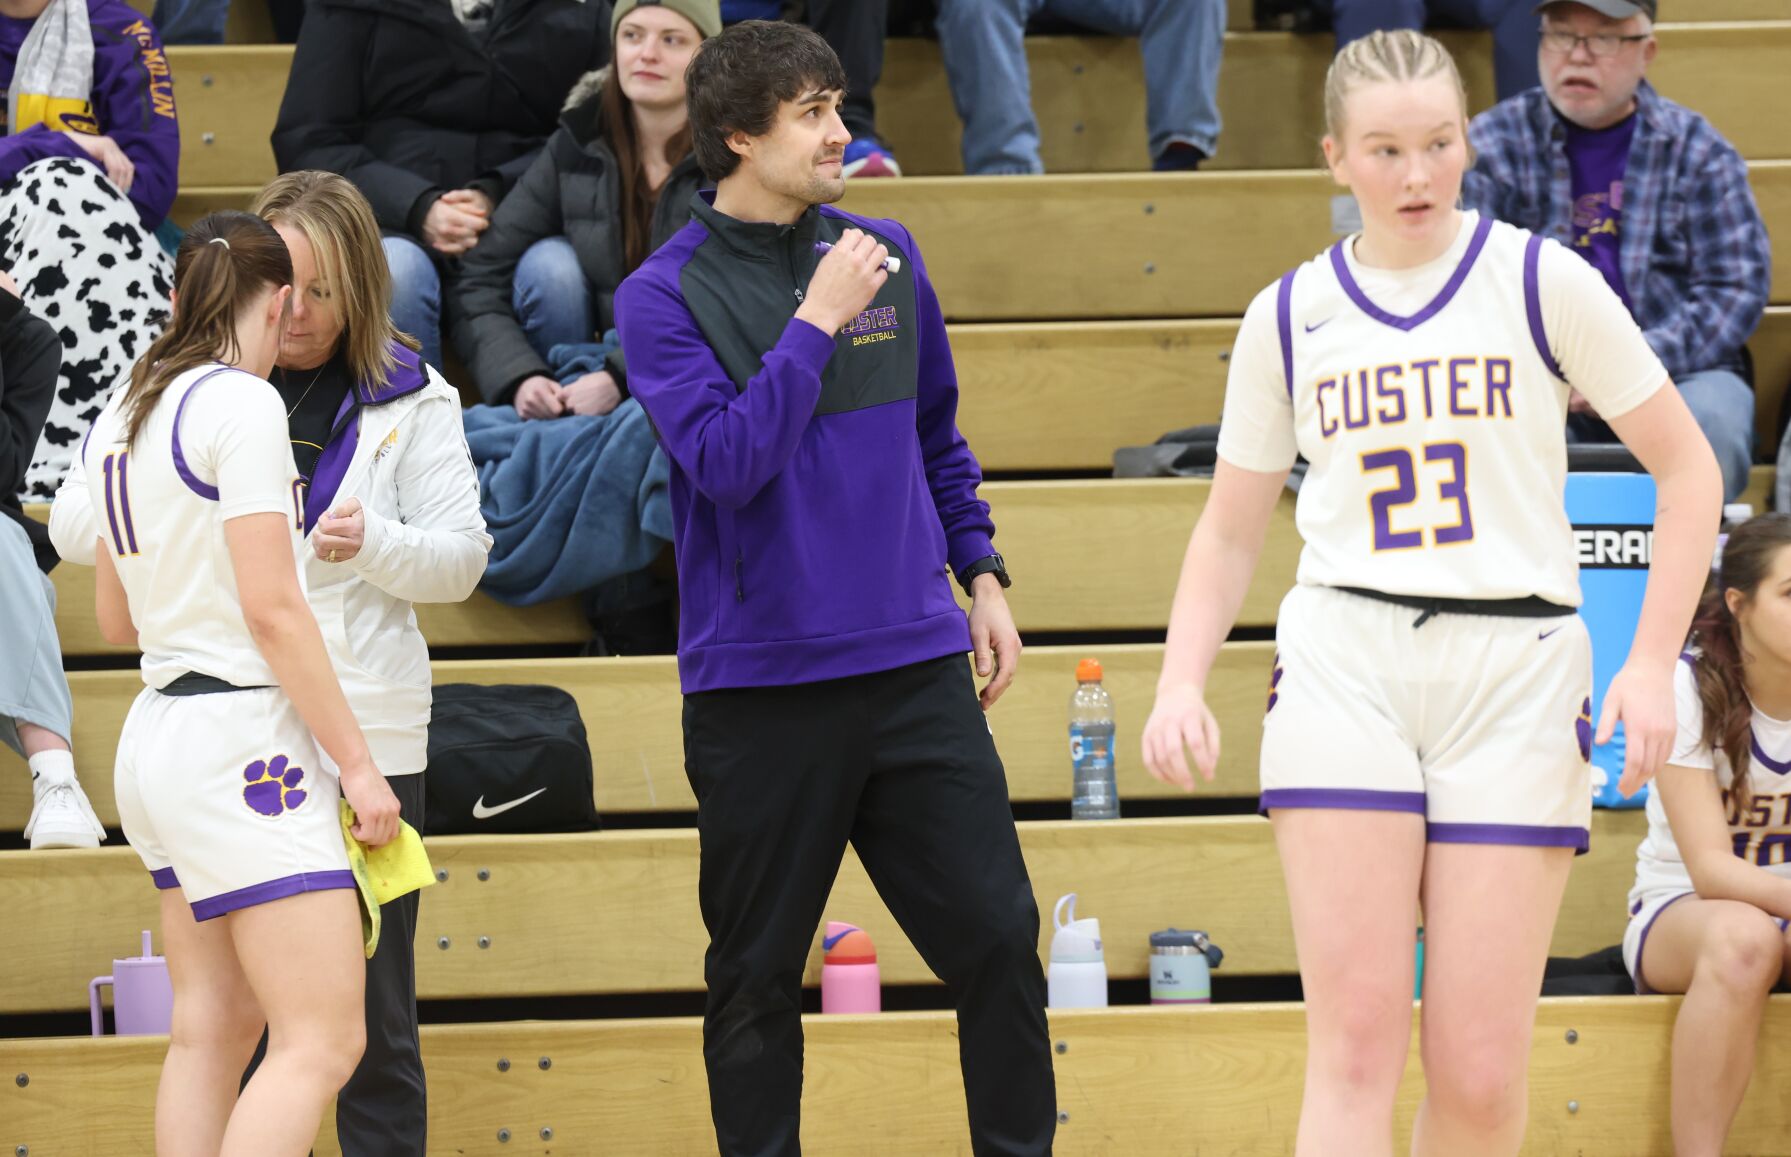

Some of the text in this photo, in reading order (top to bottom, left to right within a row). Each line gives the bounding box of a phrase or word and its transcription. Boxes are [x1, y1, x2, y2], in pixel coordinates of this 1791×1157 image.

[852, 330, 897, 346] BASKETBALL
[1315, 356, 1515, 441] CUSTER
[101, 448, 142, 558] 11
[1358, 438, 1475, 554] 23
